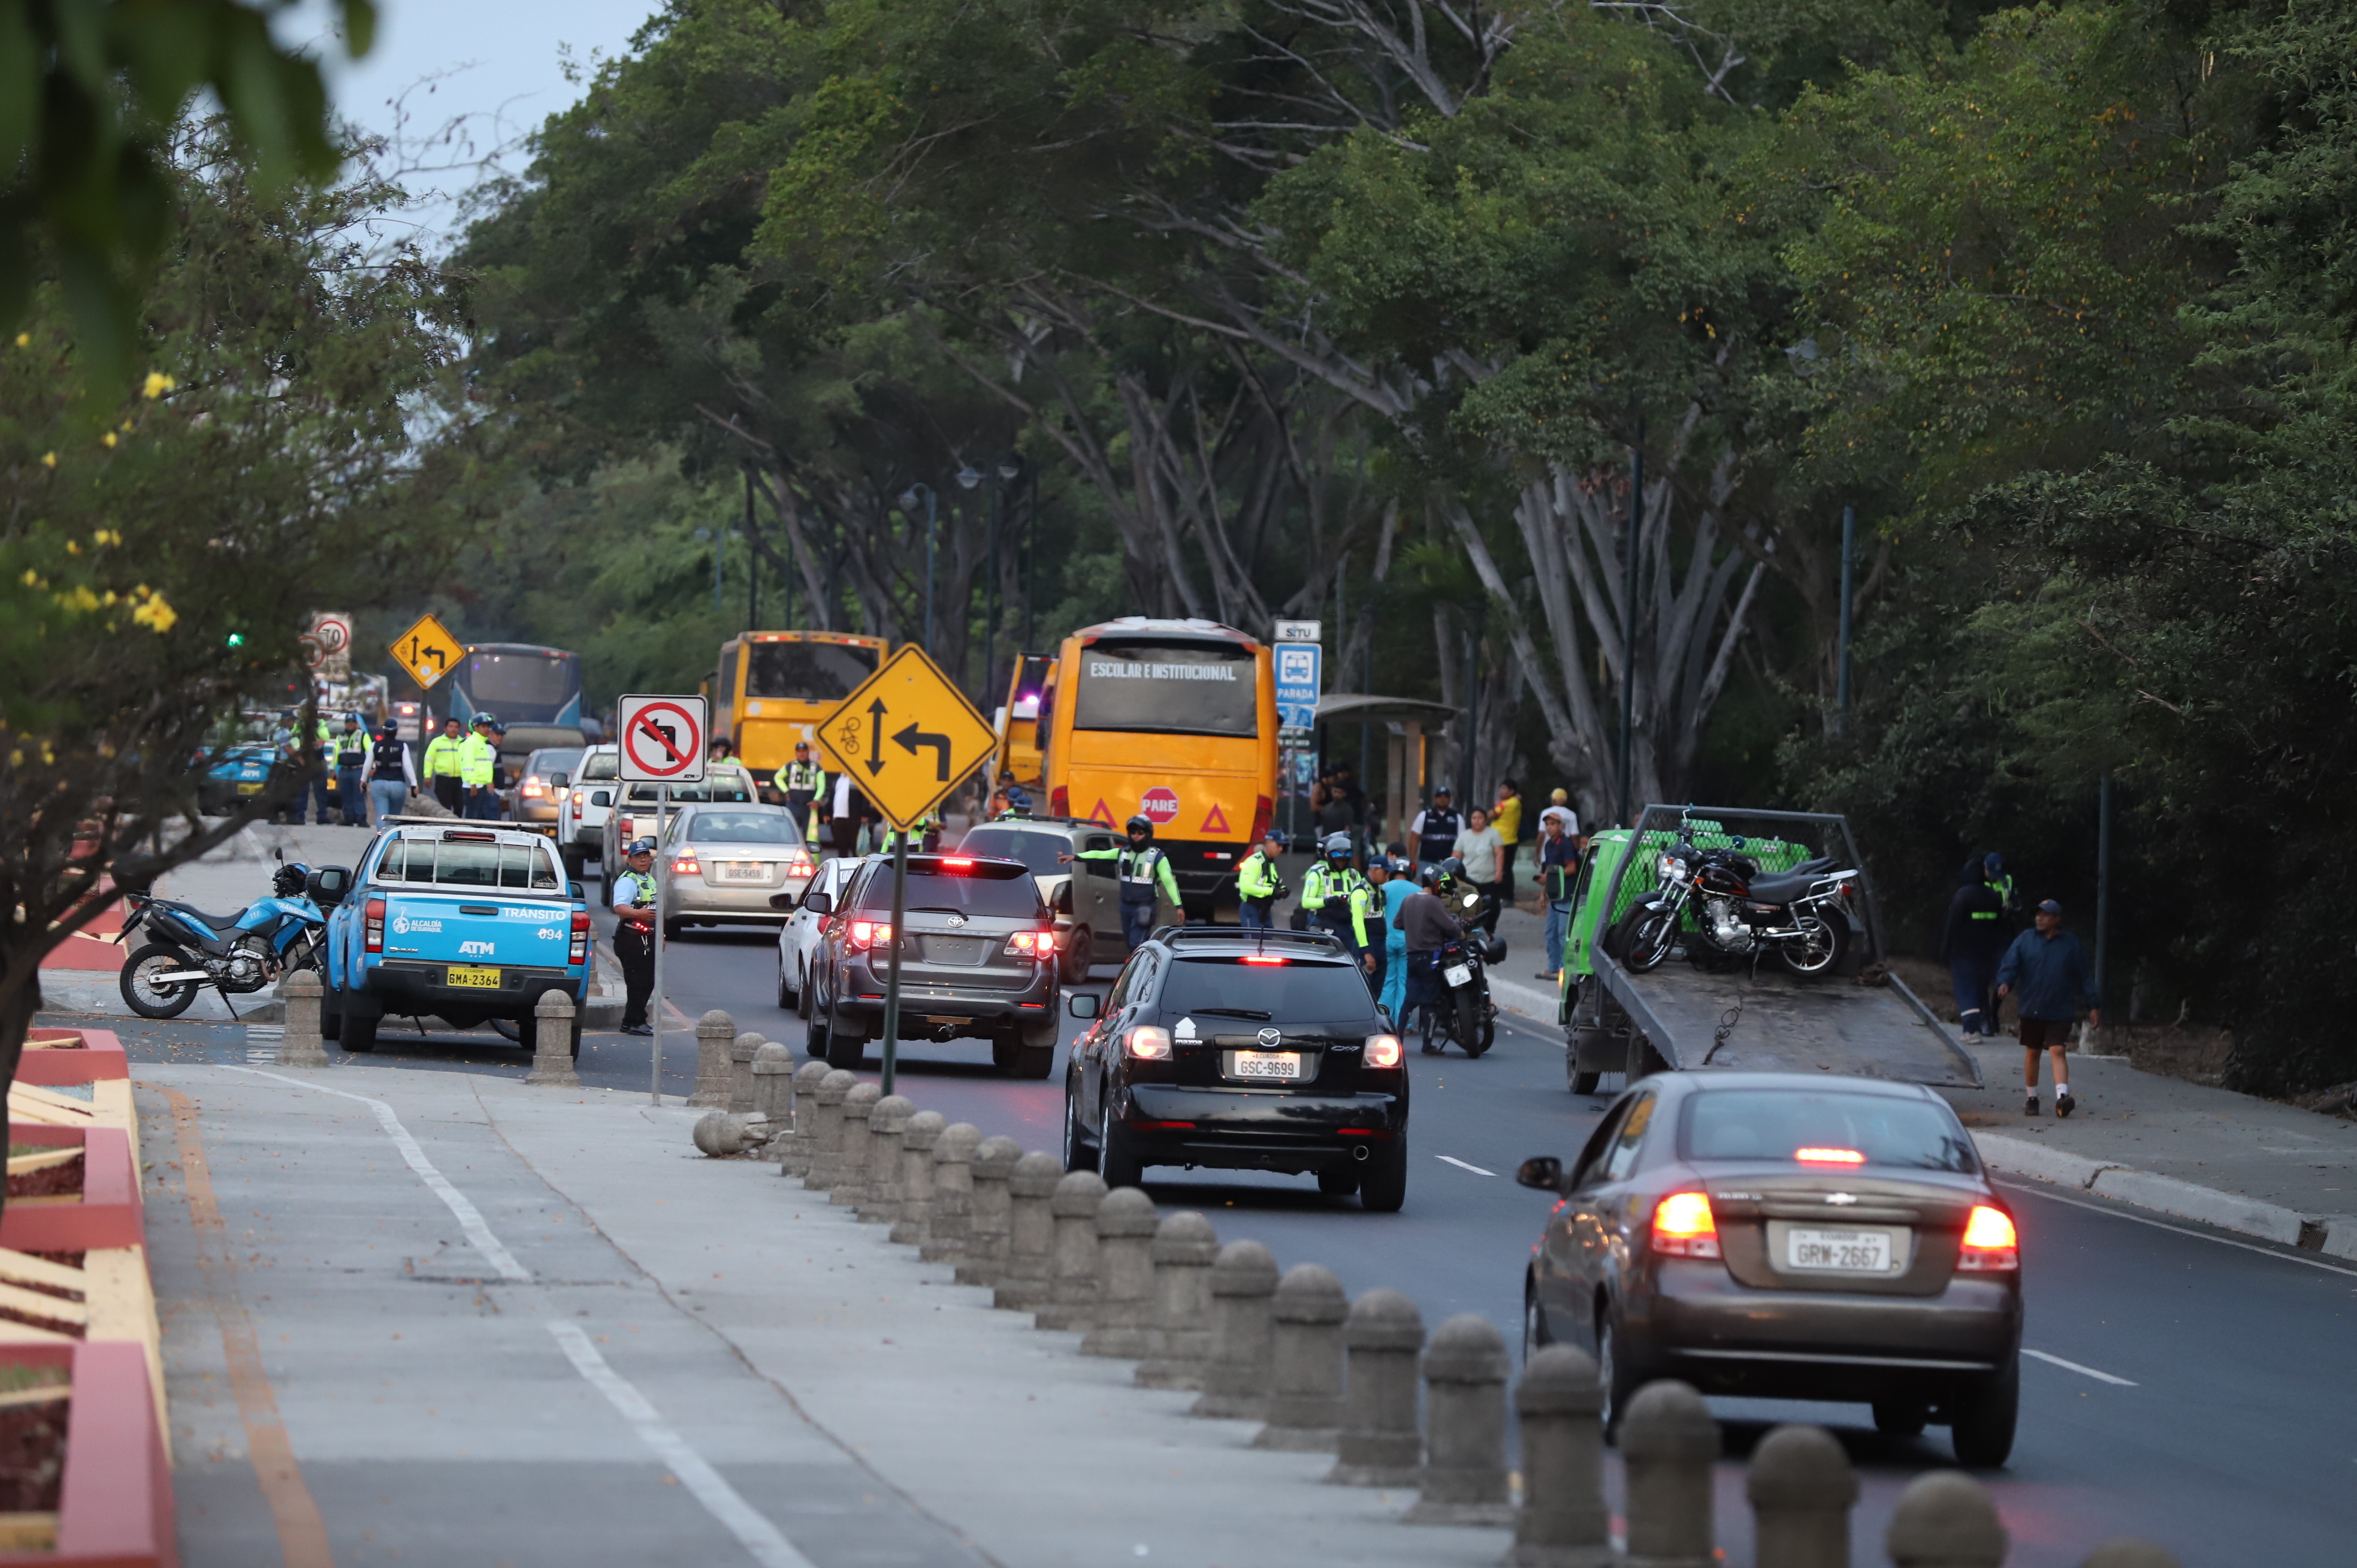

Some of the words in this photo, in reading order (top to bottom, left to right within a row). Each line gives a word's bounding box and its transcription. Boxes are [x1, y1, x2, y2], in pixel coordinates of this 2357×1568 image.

[1091, 662, 1141, 678] ESCOLAR
[1144, 664, 1150, 678] E
[1152, 664, 1236, 680] INSTITUCIONAL
[1278, 688, 1314, 699] PARADA
[1142, 799, 1177, 812] PARE
[729, 869, 760, 877] GSE-5459
[277, 902, 308, 917] TRÁNSITO
[503, 907, 565, 921] TRÁNSITO
[539, 928, 563, 940] 094
[458, 941, 495, 955] ATM
[449, 974, 499, 986] GMA-2364
[1241, 1061, 1294, 1075] GSC-9699
